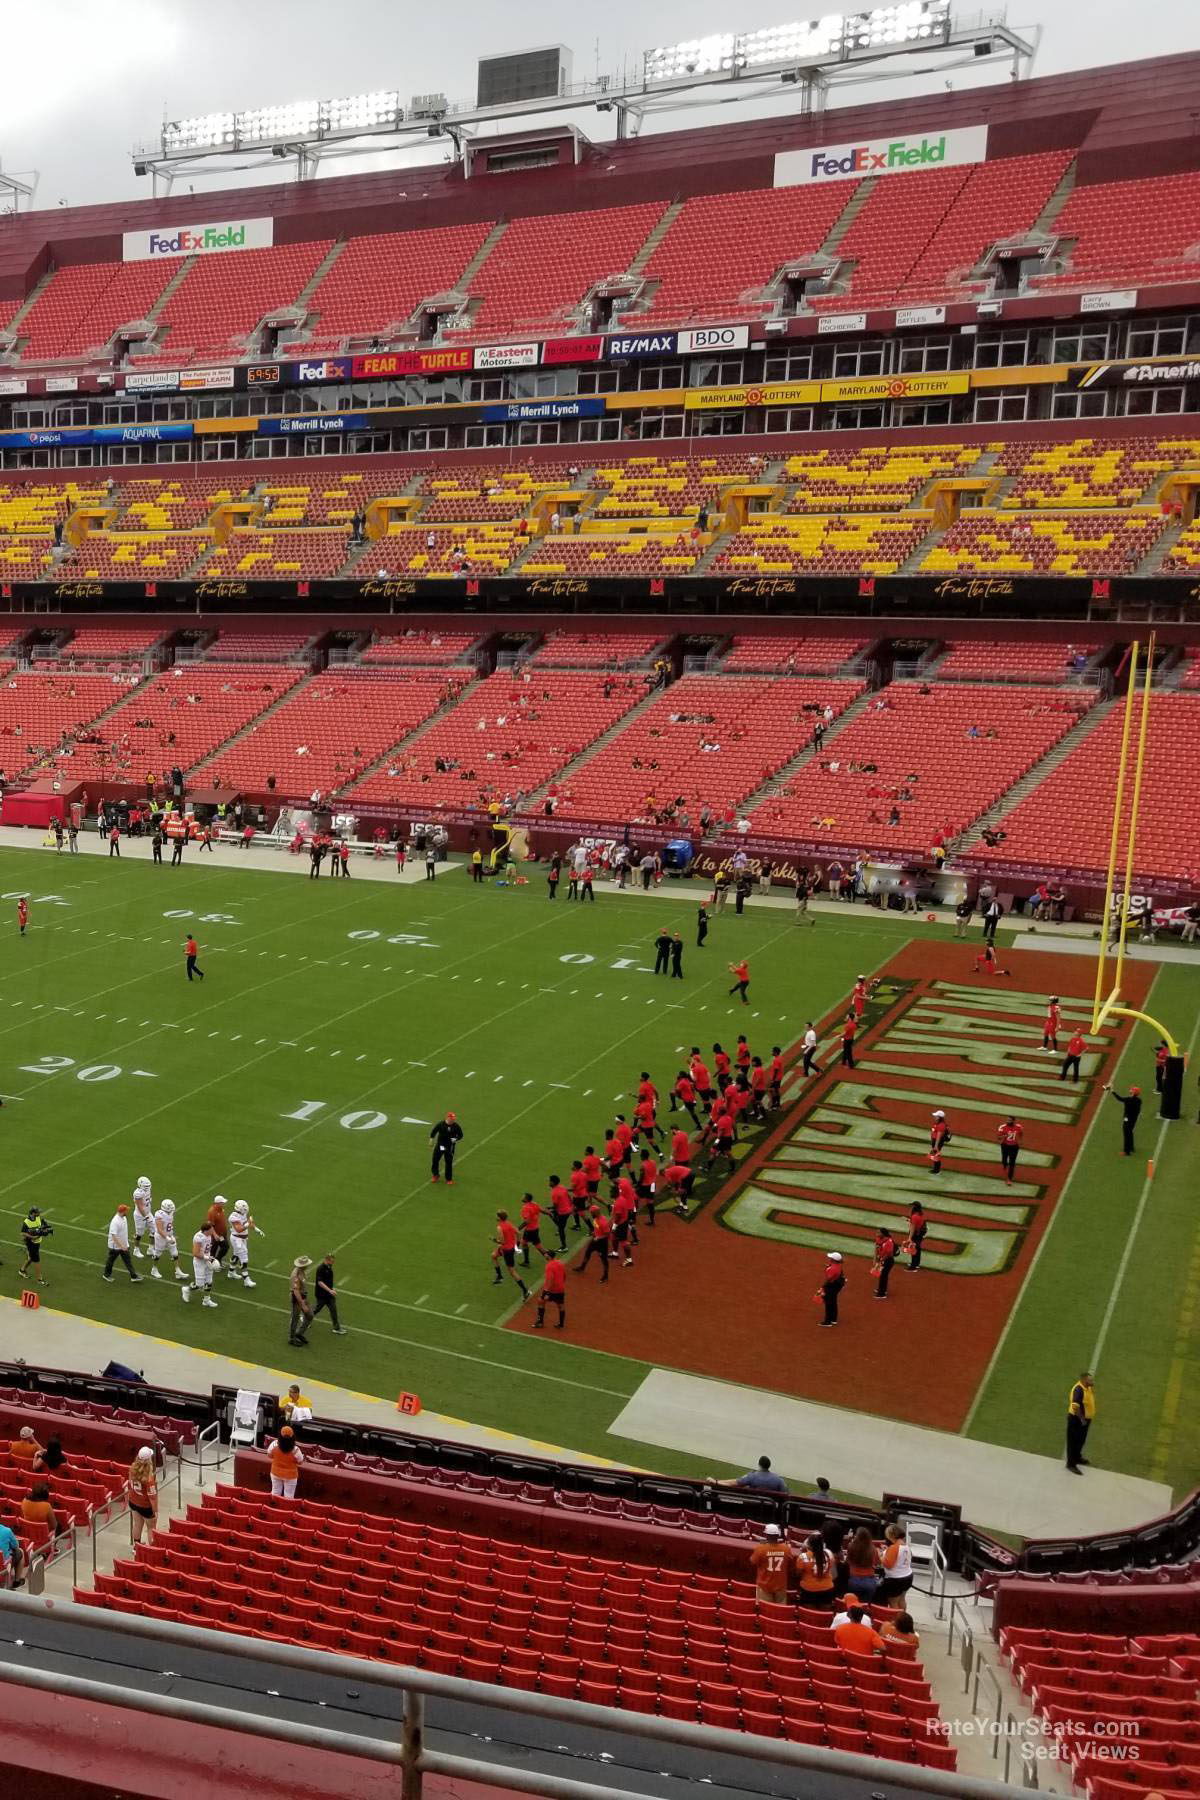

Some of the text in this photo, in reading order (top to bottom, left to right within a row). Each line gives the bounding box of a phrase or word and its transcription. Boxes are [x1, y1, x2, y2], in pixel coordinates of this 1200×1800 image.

[811, 137, 946, 177] FedExField
[150, 225, 245, 254] FedExField
[611, 337, 672, 354] RE/MAX
[694, 329, 735, 346] BDO
[488, 347, 534, 359] Eastern
[299, 363, 345, 380] FedEx
[839, 381, 949, 395] MARYLAND LOTTERY
[701, 391, 801, 403] MARYLAND LOTTERY
[521, 405, 551, 417] Merrill
[553, 404, 579, 417] Lynch
[291, 420, 318, 431] Merrill
[320, 418, 343, 431] Lynch
[39, 434, 61, 445] pepsi
[122, 427, 161, 440] AQUAFINA
[18, 1055, 123, 1082] 20
[280, 1100, 388, 1130] 10
[23, 1292, 35, 1308] 10
[402, 1395, 414, 1412] G
[767, 1557, 785, 1572] 17
